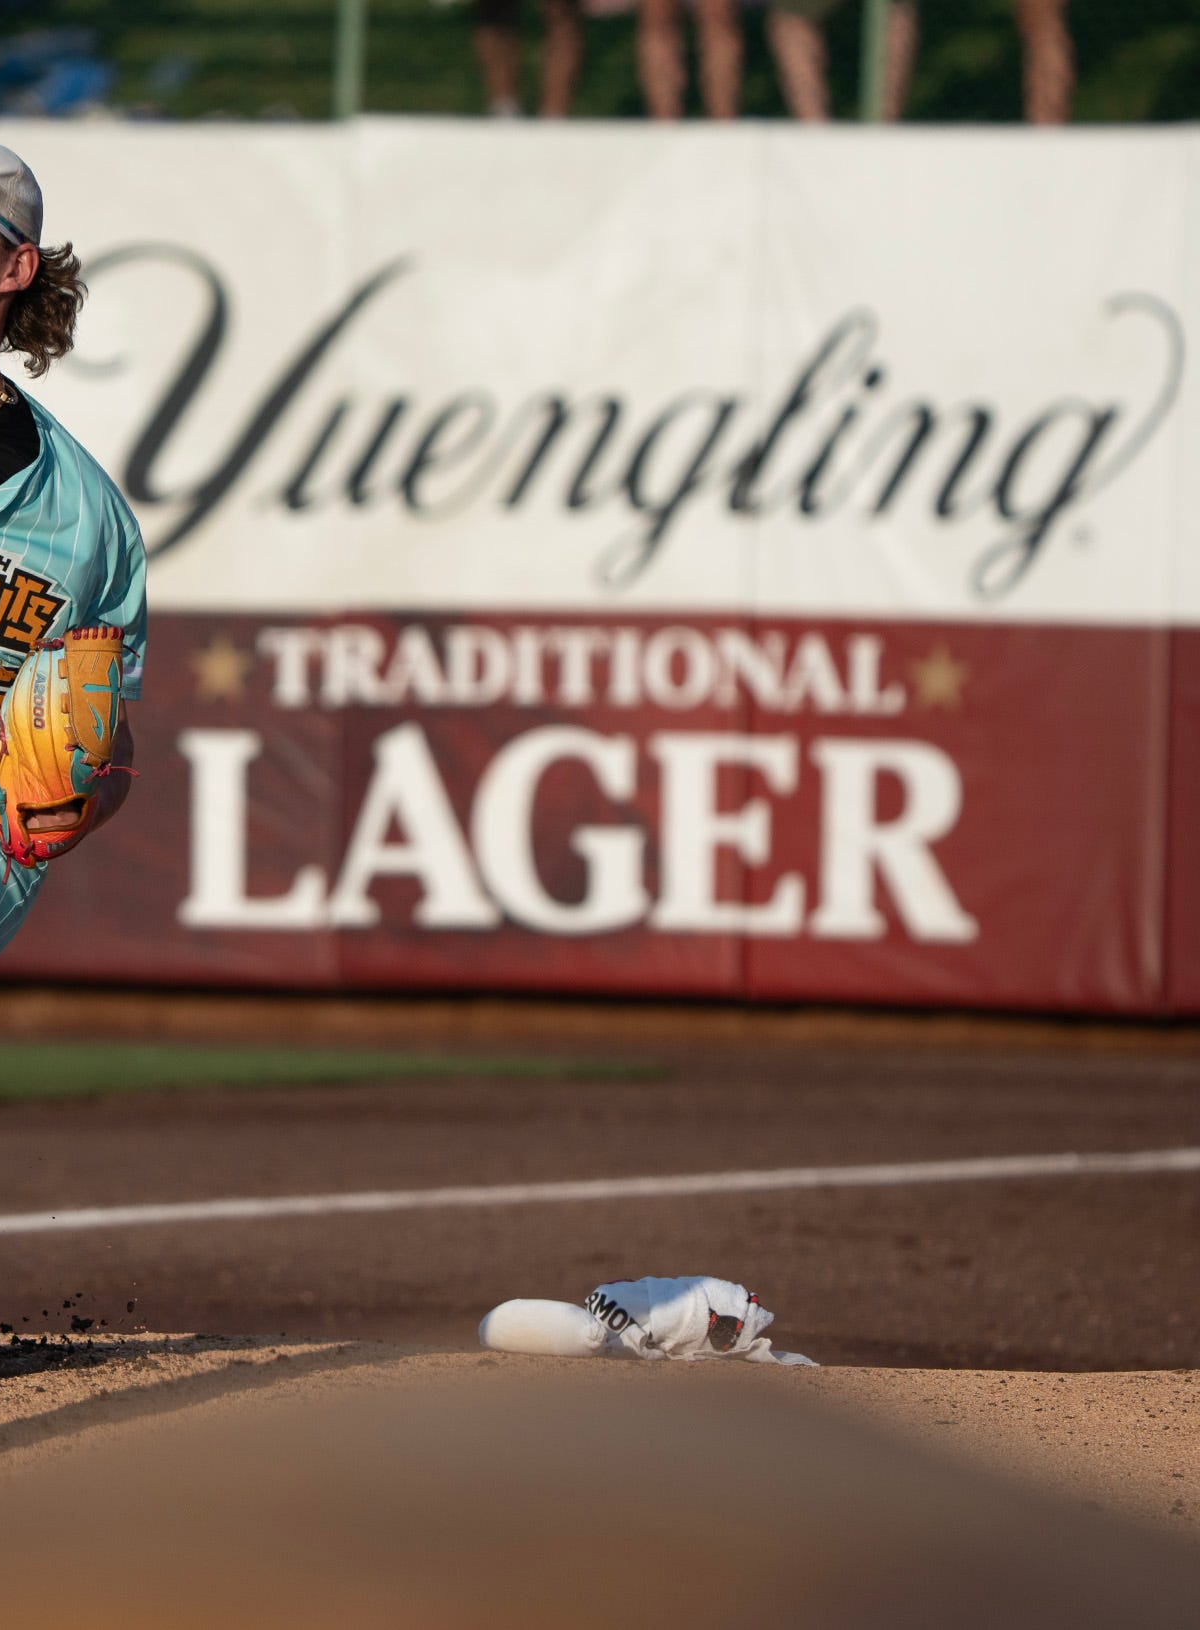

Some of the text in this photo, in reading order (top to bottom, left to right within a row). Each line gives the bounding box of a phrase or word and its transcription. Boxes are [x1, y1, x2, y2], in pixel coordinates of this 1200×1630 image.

[68, 238, 1187, 600] Yuengling
[33, 671, 48, 729] A2000
[259, 626, 906, 715] TRADITIONAL
[178, 721, 980, 943] LAGER
